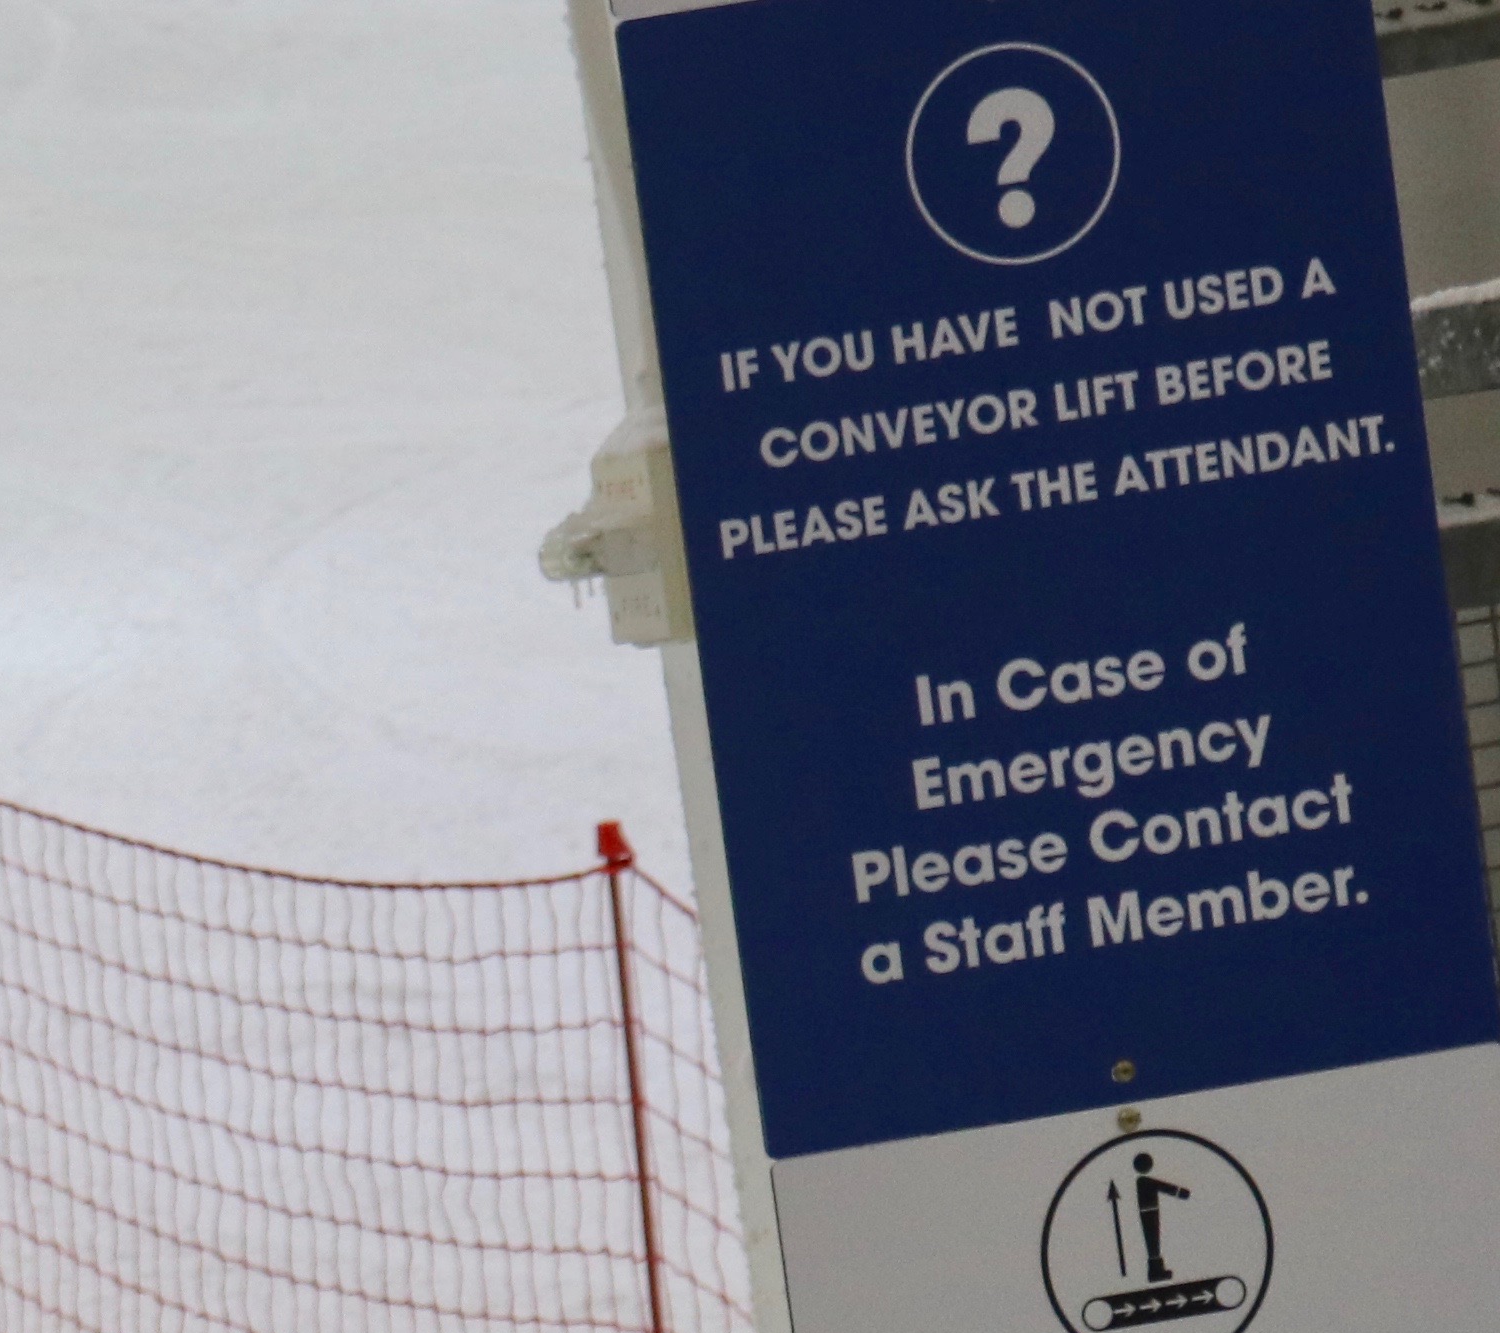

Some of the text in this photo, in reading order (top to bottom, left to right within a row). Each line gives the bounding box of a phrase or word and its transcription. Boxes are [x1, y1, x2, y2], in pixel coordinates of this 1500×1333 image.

[719, 257, 1337, 393] IF YOU HAVE NOT USED A
[759, 339, 1333, 469] CONVEYOR LIFT BEFORE
[718, 414, 1396, 560] PLEASE ASK THE ATTENDANT.
[914, 621, 1248, 727] In Case of
[911, 713, 1272, 811] Emergency
[850, 772, 1353, 904] Please Contact
[860, 865, 1370, 985] a Staff Member.
